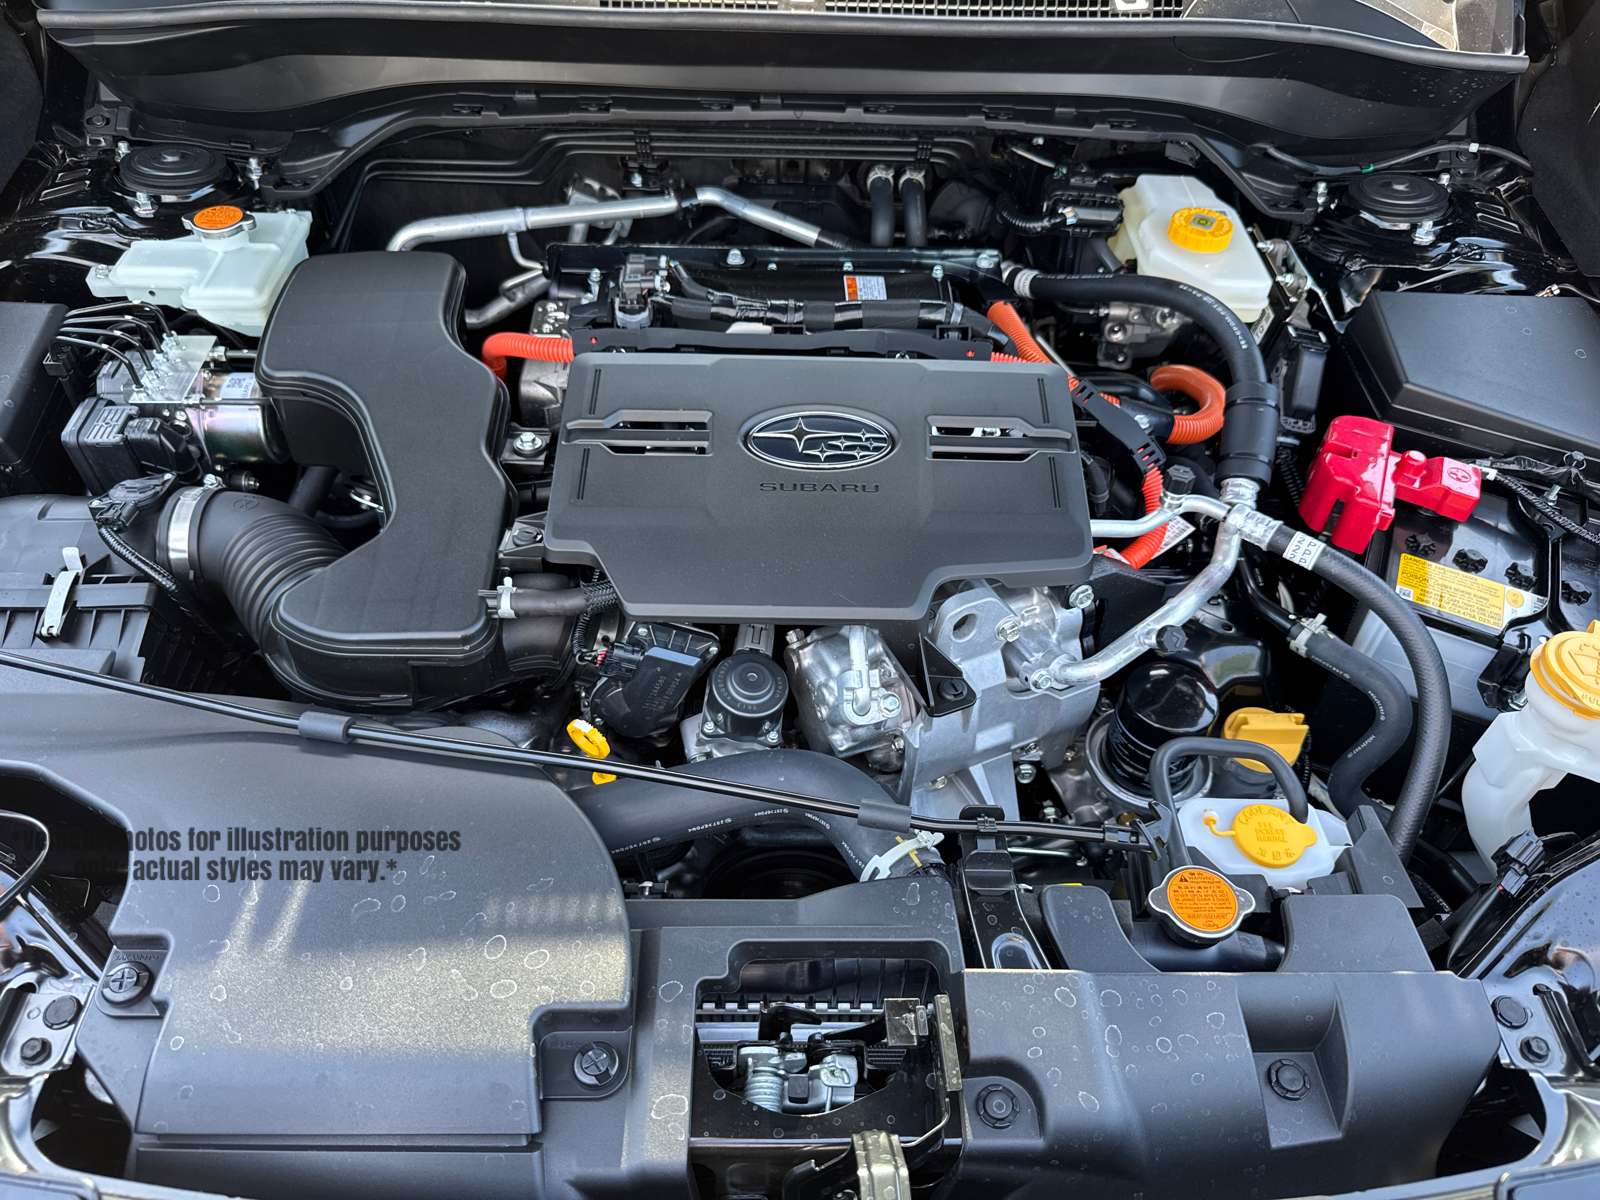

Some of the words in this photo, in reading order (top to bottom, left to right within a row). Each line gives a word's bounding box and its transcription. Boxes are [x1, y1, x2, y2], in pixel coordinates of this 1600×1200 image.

[759, 482, 880, 493] SUBARU
[1237, 805, 1295, 825] COOLANT
[1256, 834, 1287, 843] MANUAL
